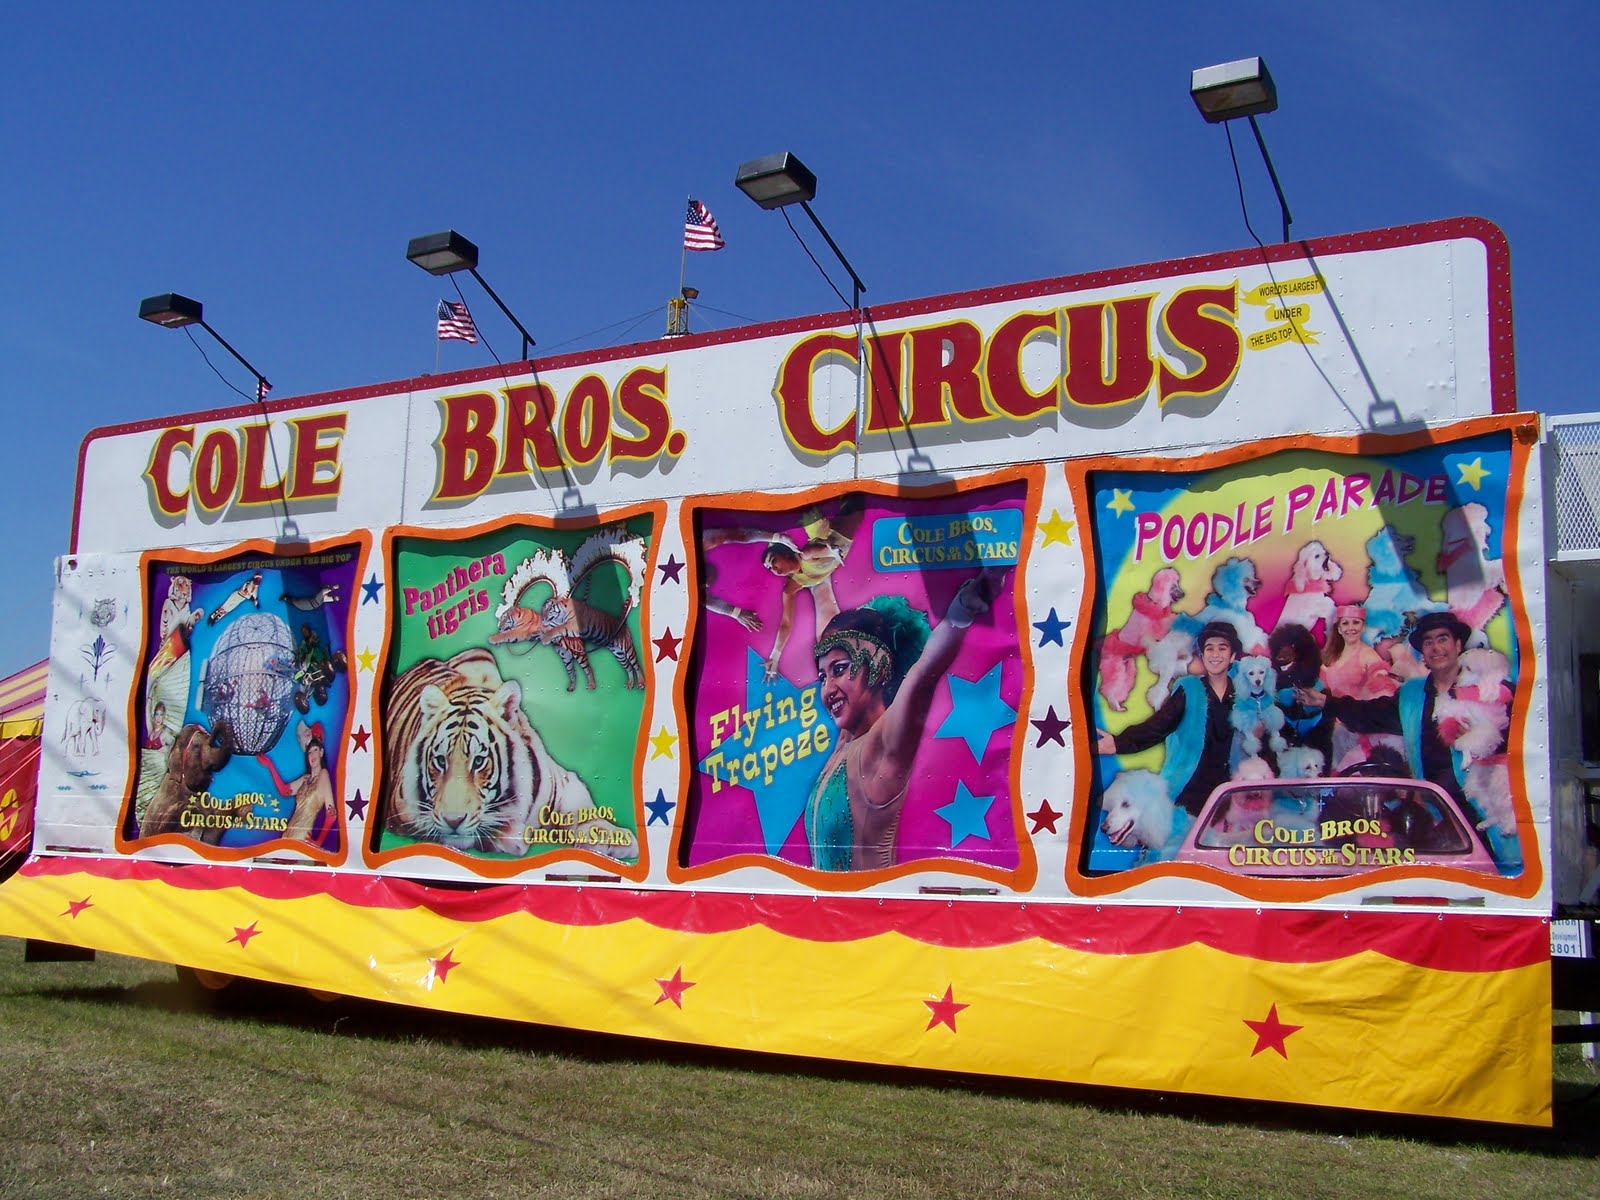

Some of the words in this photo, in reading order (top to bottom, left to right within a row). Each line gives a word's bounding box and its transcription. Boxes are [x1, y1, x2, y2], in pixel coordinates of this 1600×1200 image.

[1259, 284, 1288, 297] WORLD'S
[1289, 280, 1318, 293] LARGEST
[1274, 307, 1302, 319] UNDER
[1250, 335, 1265, 347] THE
[1265, 331, 1278, 344] BIG
[1278, 328, 1293, 340] TOP
[147, 410, 348, 518] COLE
[433, 363, 688, 500] BROS.
[774, 280, 1243, 454] CIRCUS
[1132, 494, 1276, 565] POODLE
[1282, 468, 1450, 536] PARADE
[897, 521, 945, 546] COLE
[947, 516, 998, 539] BROS.
[213, 561, 246, 572] LARGEST
[247, 560, 275, 569] CIRCUS
[275, 557, 302, 568] UNDER
[320, 555, 334, 564] BIG
[335, 553, 352, 562] TOP
[878, 545, 946, 567] CIRCUS
[963, 539, 1018, 561] STARS
[402, 551, 507, 616] Panthera
[425, 588, 490, 640] tigris
[709, 687, 818, 750] Flying
[705, 723, 830, 794] Trapeze
[200, 791, 233, 811] COLE
[233, 791, 267, 808] BROS.
[180, 809, 233, 829] CIRCUS
[245, 811, 288, 832] STARS
[538, 805, 575, 826] COLE
[577, 805, 617, 824] BROS.
[523, 825, 576, 845] CIRCUS
[588, 825, 633, 847] STARS
[1253, 818, 1316, 845] COLE
[1319, 817, 1388, 841] BROS.
[1228, 843, 1317, 867] CIRCUS
[1322, 849, 1334, 859] OF
[1341, 842, 1417, 867] STARS
[1550, 944, 1576, 954] 3801
